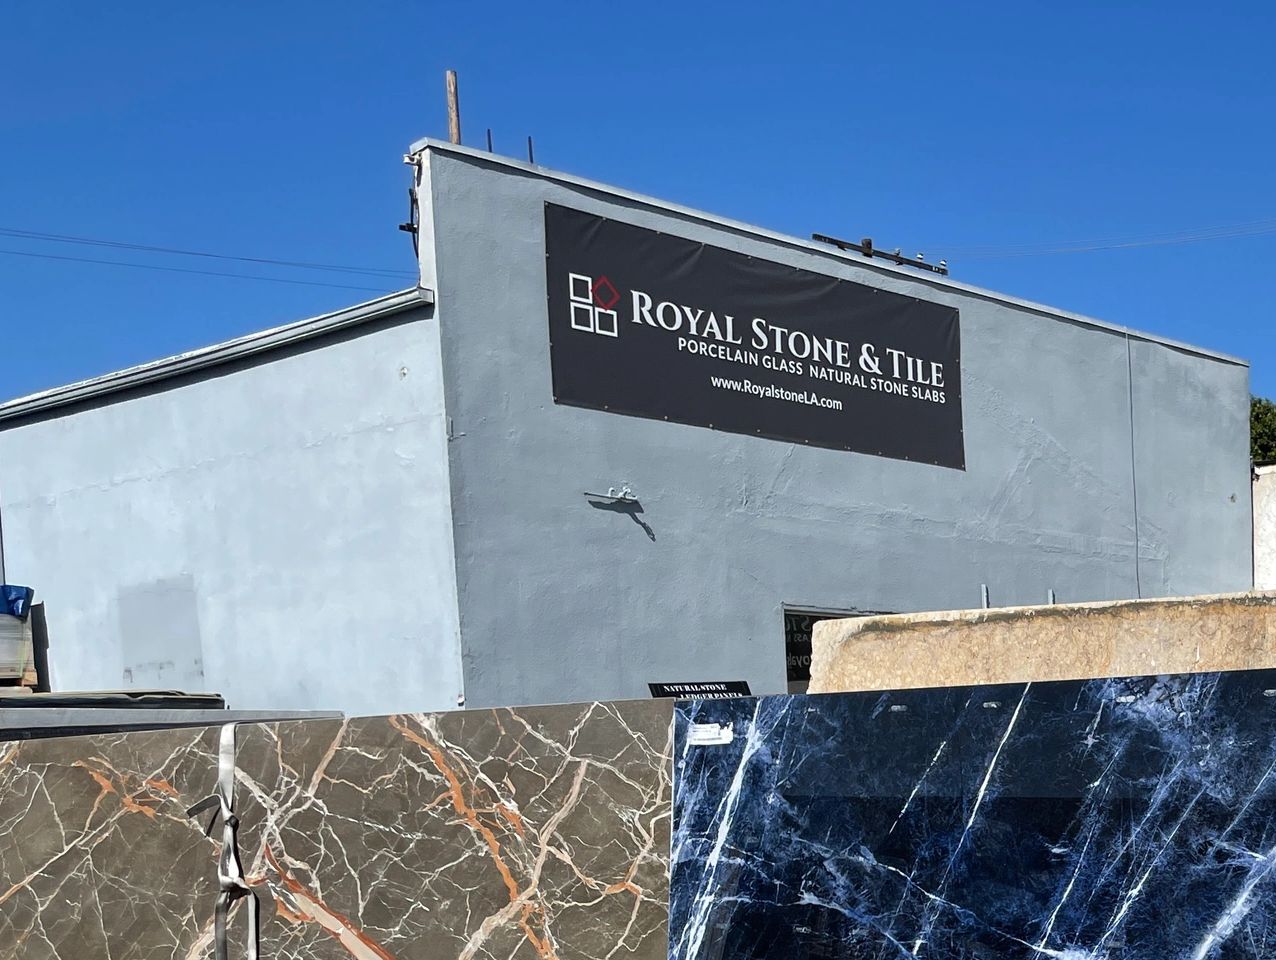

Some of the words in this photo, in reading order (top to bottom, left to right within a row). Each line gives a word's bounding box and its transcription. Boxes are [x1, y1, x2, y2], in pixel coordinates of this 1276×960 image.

[630, 290, 743, 345] ROYAL
[751, 318, 852, 368] STONE
[858, 343, 883, 375] &
[886, 347, 945, 388] TILE
[678, 337, 758, 366] PORCELAIN
[762, 355, 803, 375] GLASS
[809, 364, 867, 389] NATURAL
[870, 378, 909, 397] STONE
[911, 386, 946, 404] SLABS
[711, 376, 843, 411] www.RoyalstoneLA.com
